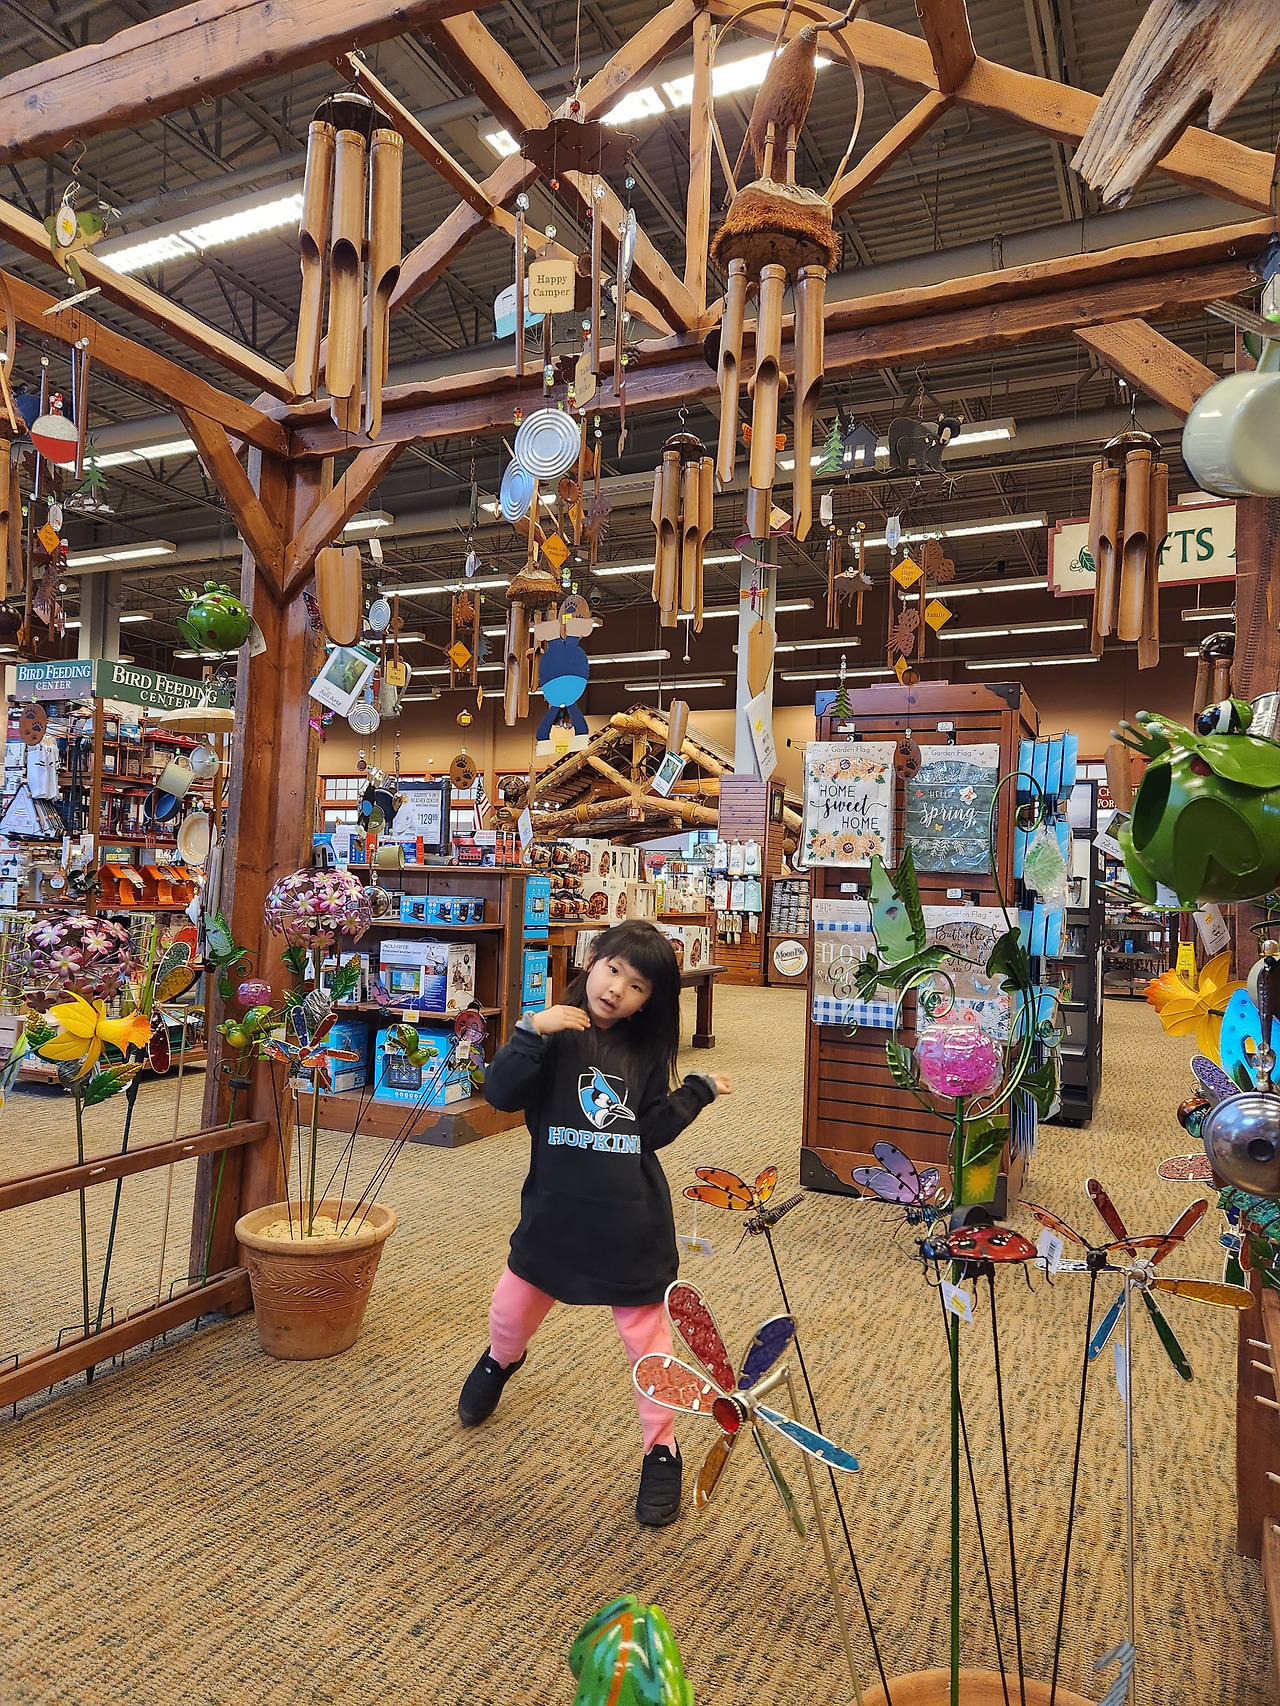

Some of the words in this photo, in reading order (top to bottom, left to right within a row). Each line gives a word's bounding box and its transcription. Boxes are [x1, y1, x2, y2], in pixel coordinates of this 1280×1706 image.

[536, 274, 567, 285] Happy
[532, 288, 570, 298] Camper
[1159, 527, 1215, 566] FTS
[18, 666, 44, 681] BIRD
[45, 664, 91, 680] FEEDING
[35, 680, 71, 691] CENTER
[112, 664, 152, 691] BIRD
[155, 674, 218, 704] FEEDING
[139, 689, 191, 709] CENTER
[856, 746, 871, 754] Flag
[956, 749, 972, 757] Flag
[820, 785, 856, 798] HOME
[810, 794, 888, 818] sweet
[842, 817, 879, 829] HOME
[944, 910, 970, 918] Garden
[971, 910, 987, 919] Flag
[821, 943, 877, 964] HOM
